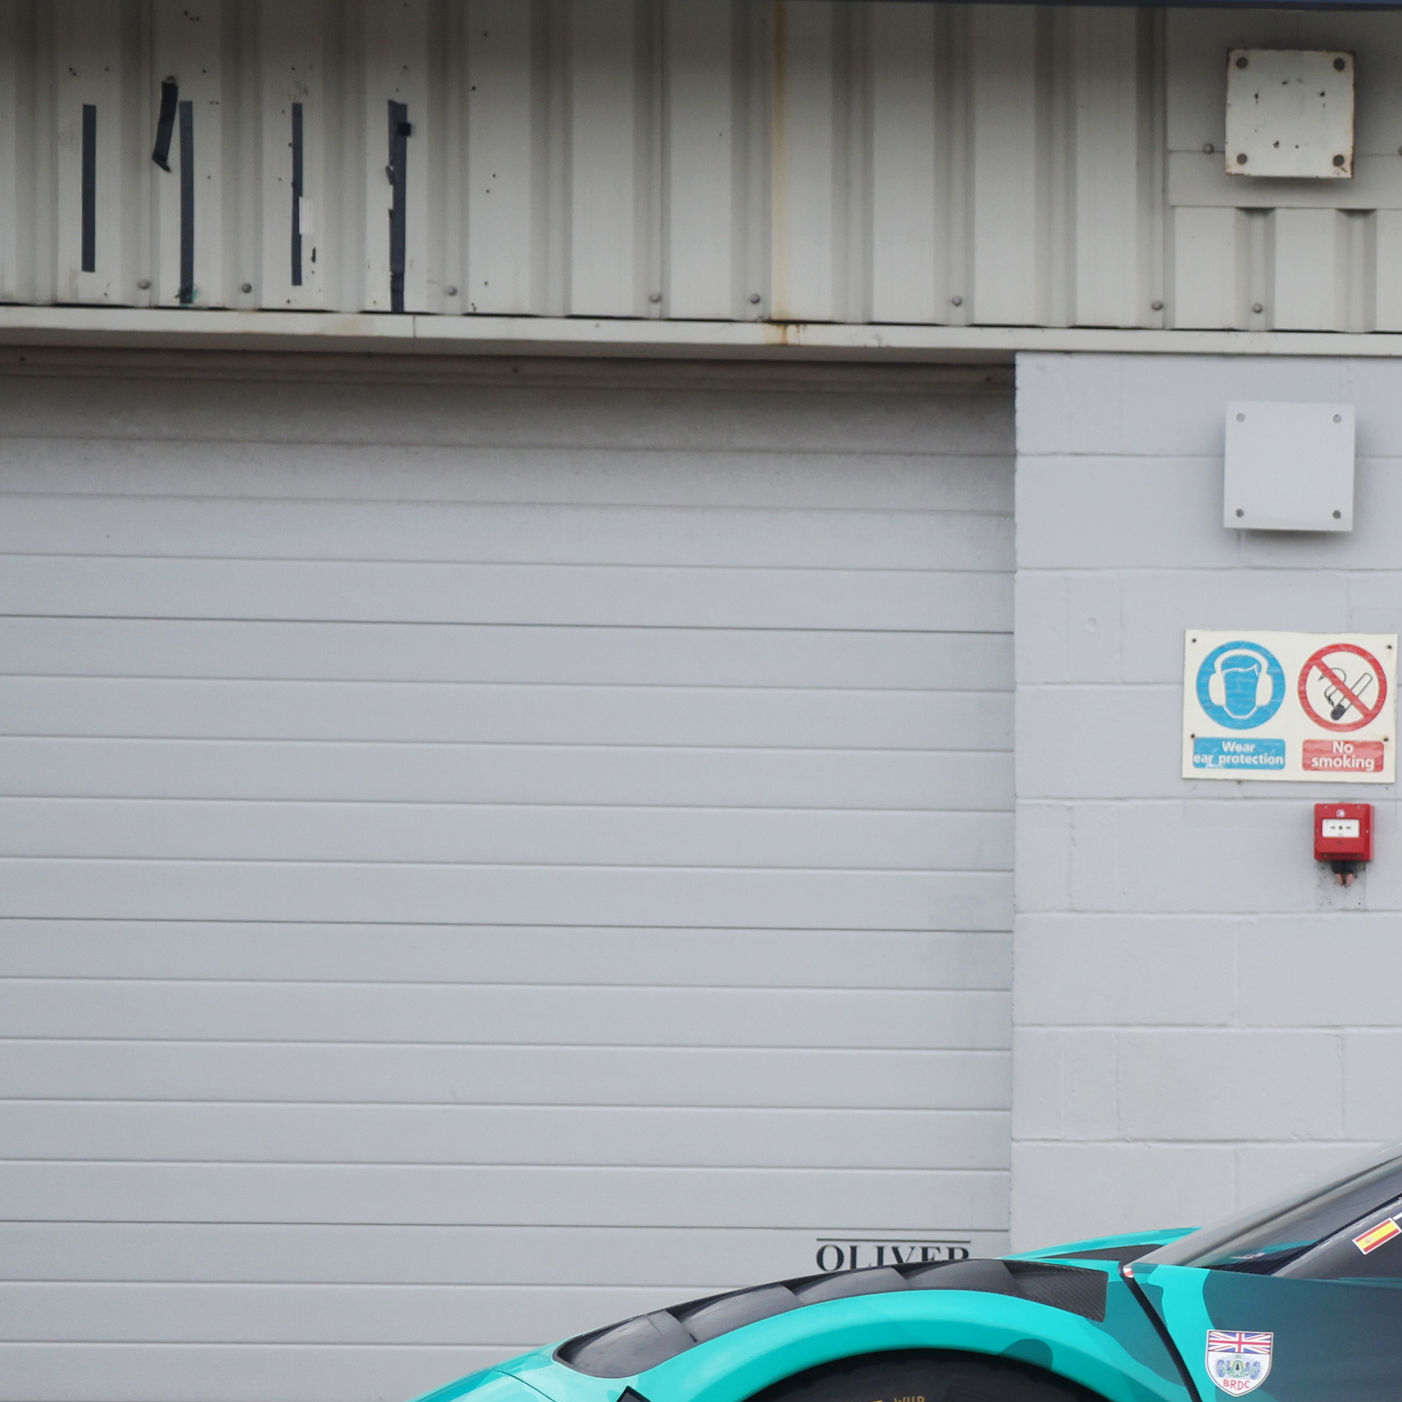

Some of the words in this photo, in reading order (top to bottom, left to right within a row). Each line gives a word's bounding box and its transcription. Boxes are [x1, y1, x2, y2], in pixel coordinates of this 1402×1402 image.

[1222, 741, 1255, 753] Wear
[1332, 741, 1354, 754] No
[1219, 753, 1283, 766] protection
[1311, 755, 1375, 772] smoking
[1223, 1378, 1251, 1391] BRDC
